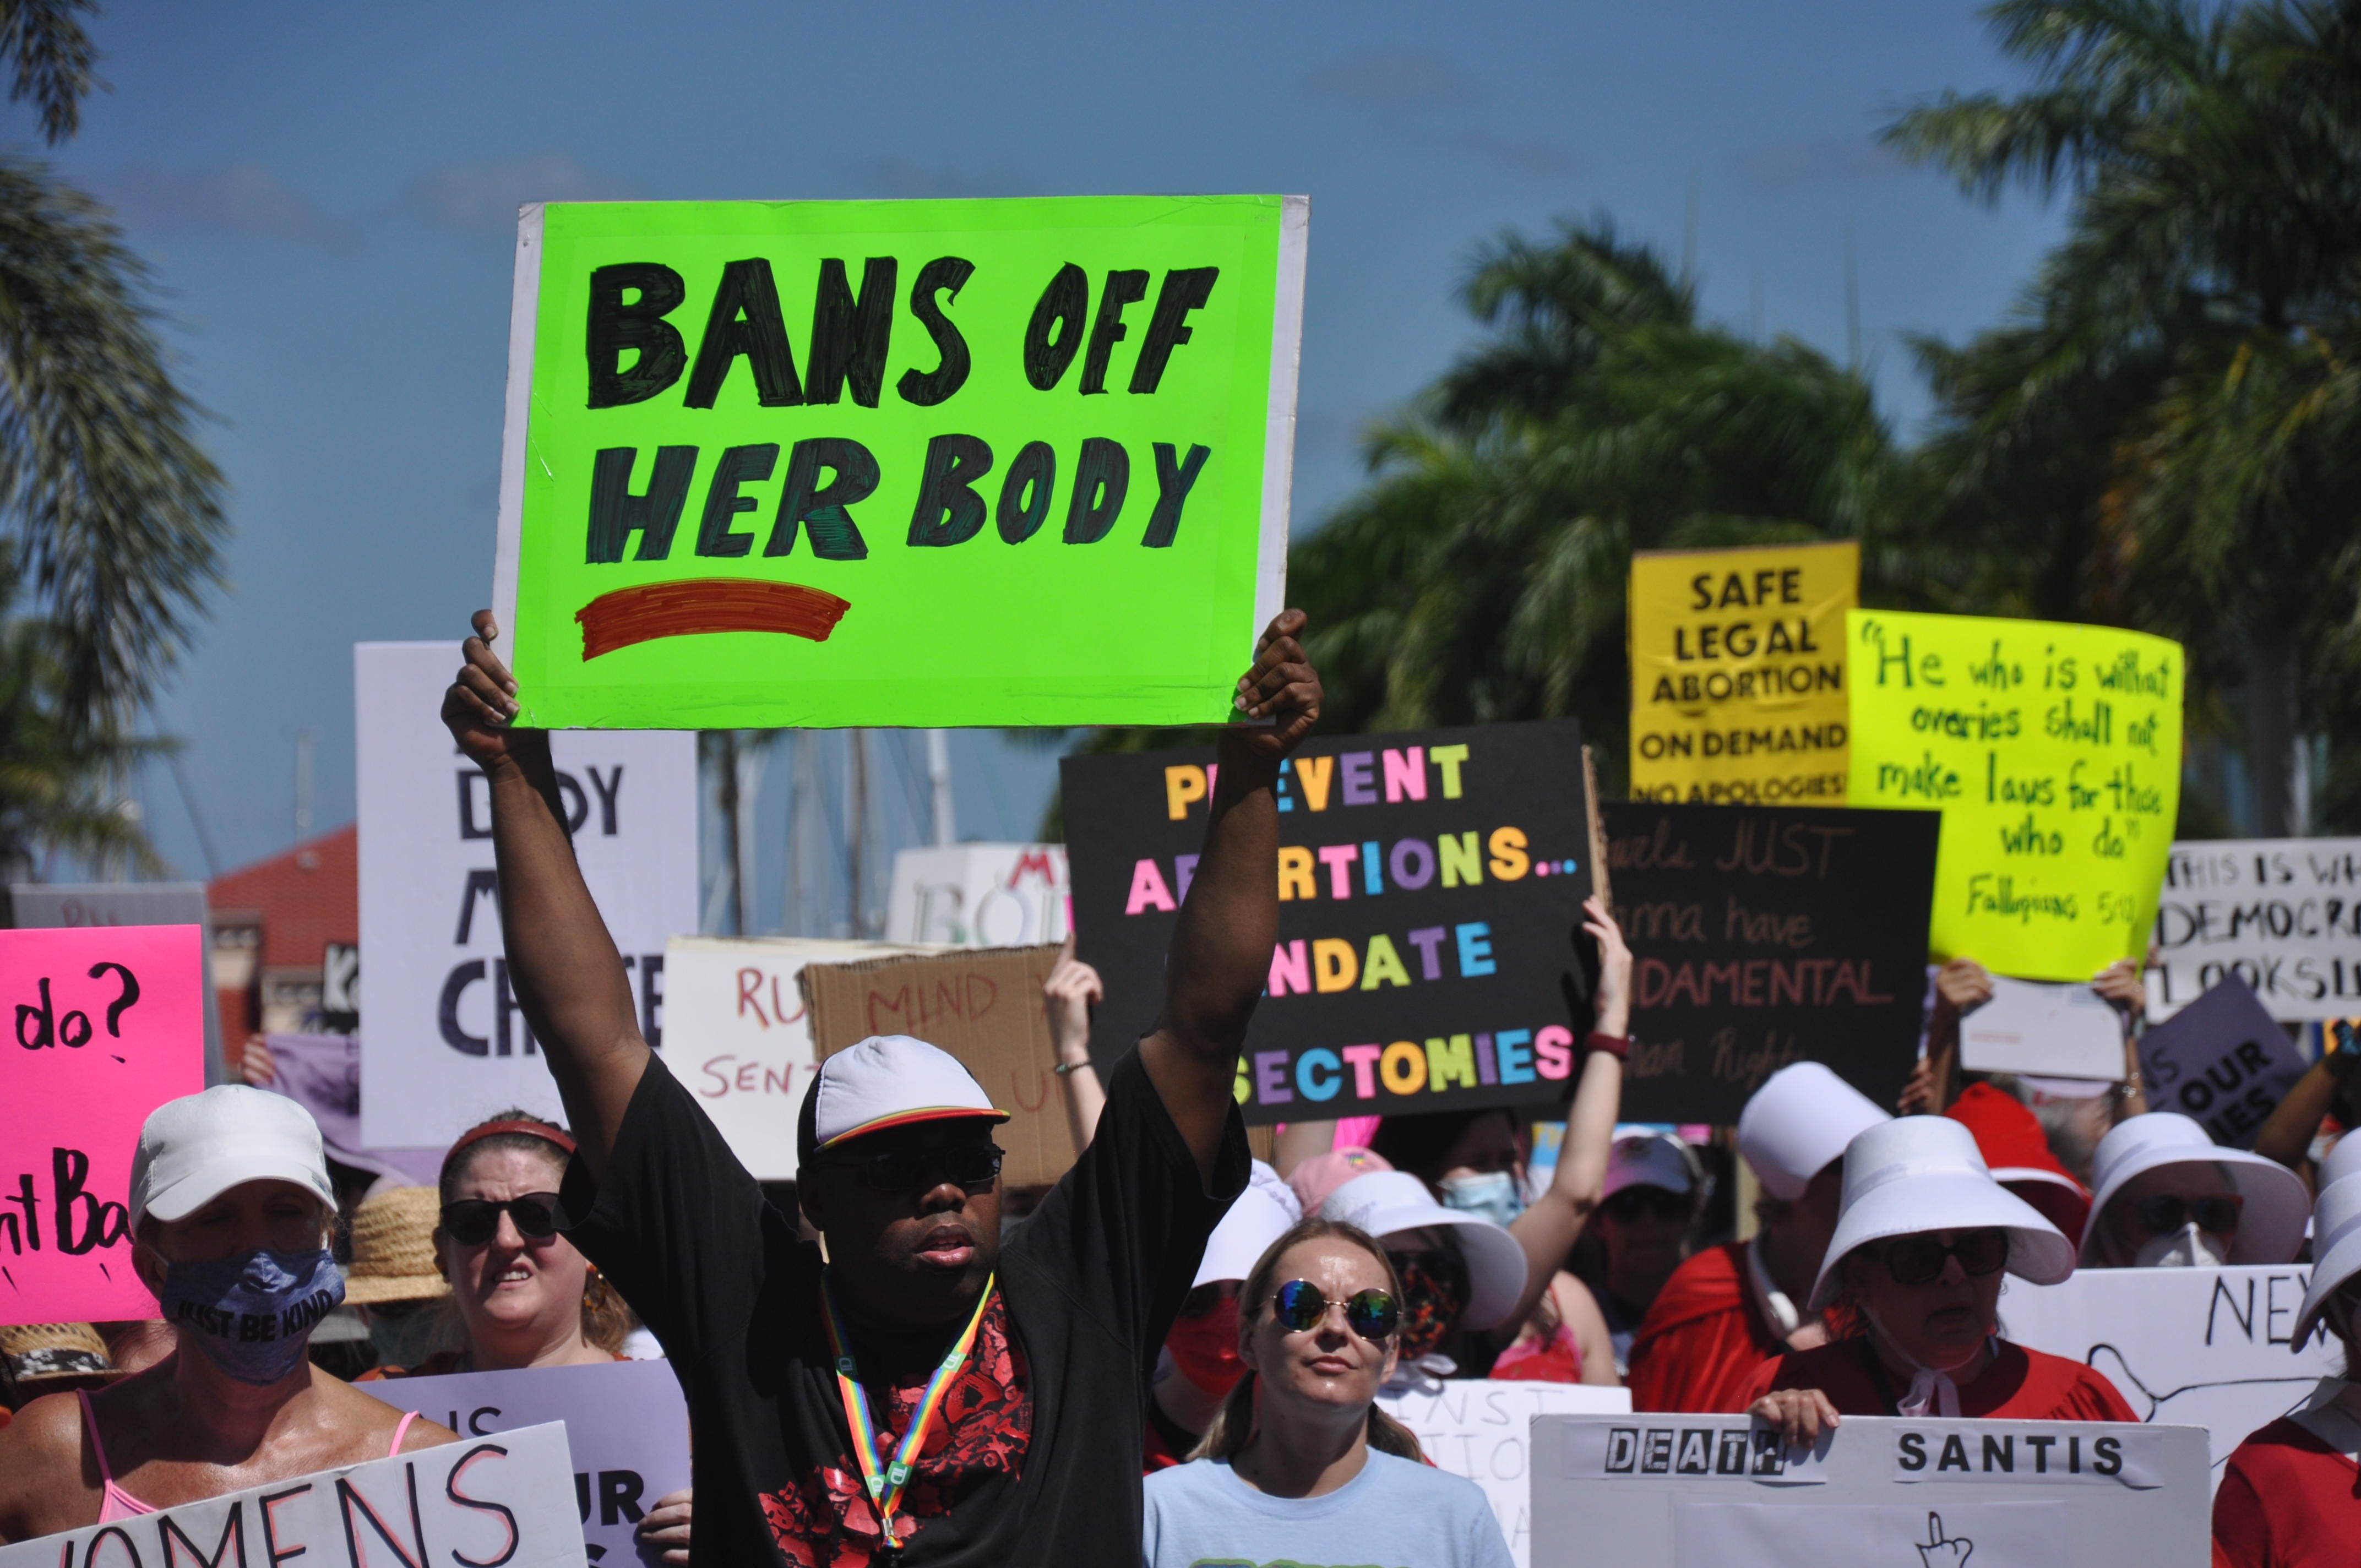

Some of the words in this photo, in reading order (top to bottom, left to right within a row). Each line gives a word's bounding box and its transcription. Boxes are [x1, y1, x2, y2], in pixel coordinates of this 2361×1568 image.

[586, 257, 975, 409] BANS
[1023, 261, 1219, 395] OFF
[585, 438, 881, 564] HER
[906, 434, 1211, 548] BODY
[1691, 568, 1802, 611] SAFE
[1674, 619, 1819, 661] LEGAL
[1968, 640, 2023, 690] who
[2044, 644, 2077, 689] is
[1651, 664, 1842, 703] ABORTION
[1639, 730, 1693, 760] ON
[1702, 723, 1847, 758] DEMAND
[2044, 697, 2111, 745] shall
[1165, 743, 1469, 821] PVENT
[1878, 750, 1962, 799] make
[1986, 750, 2056, 807] laws
[1716, 819, 1856, 880] JUST
[1999, 814, 2065, 856] who
[1125, 826, 1577, 916] ARTIONS...
[2255, 852, 2294, 885] IS
[1726, 895, 1816, 949] have
[1262, 922, 1496, 998] NDATE
[1633, 958, 1895, 1008] DAMENTAL
[15, 961, 140, 1064] do?
[866, 972, 998, 1035] MIND
[1233, 1025, 1574, 1106] SECTOMIES
[2179, 1039, 2273, 1112] OUR
[53, 1147, 135, 1255] Ba
[238, 1313, 276, 1342] BE
[282, 1289, 335, 1338] KIND
[1606, 1429, 1787, 1474] DEATH
[1897, 1433, 2123, 1476] SANTIS
